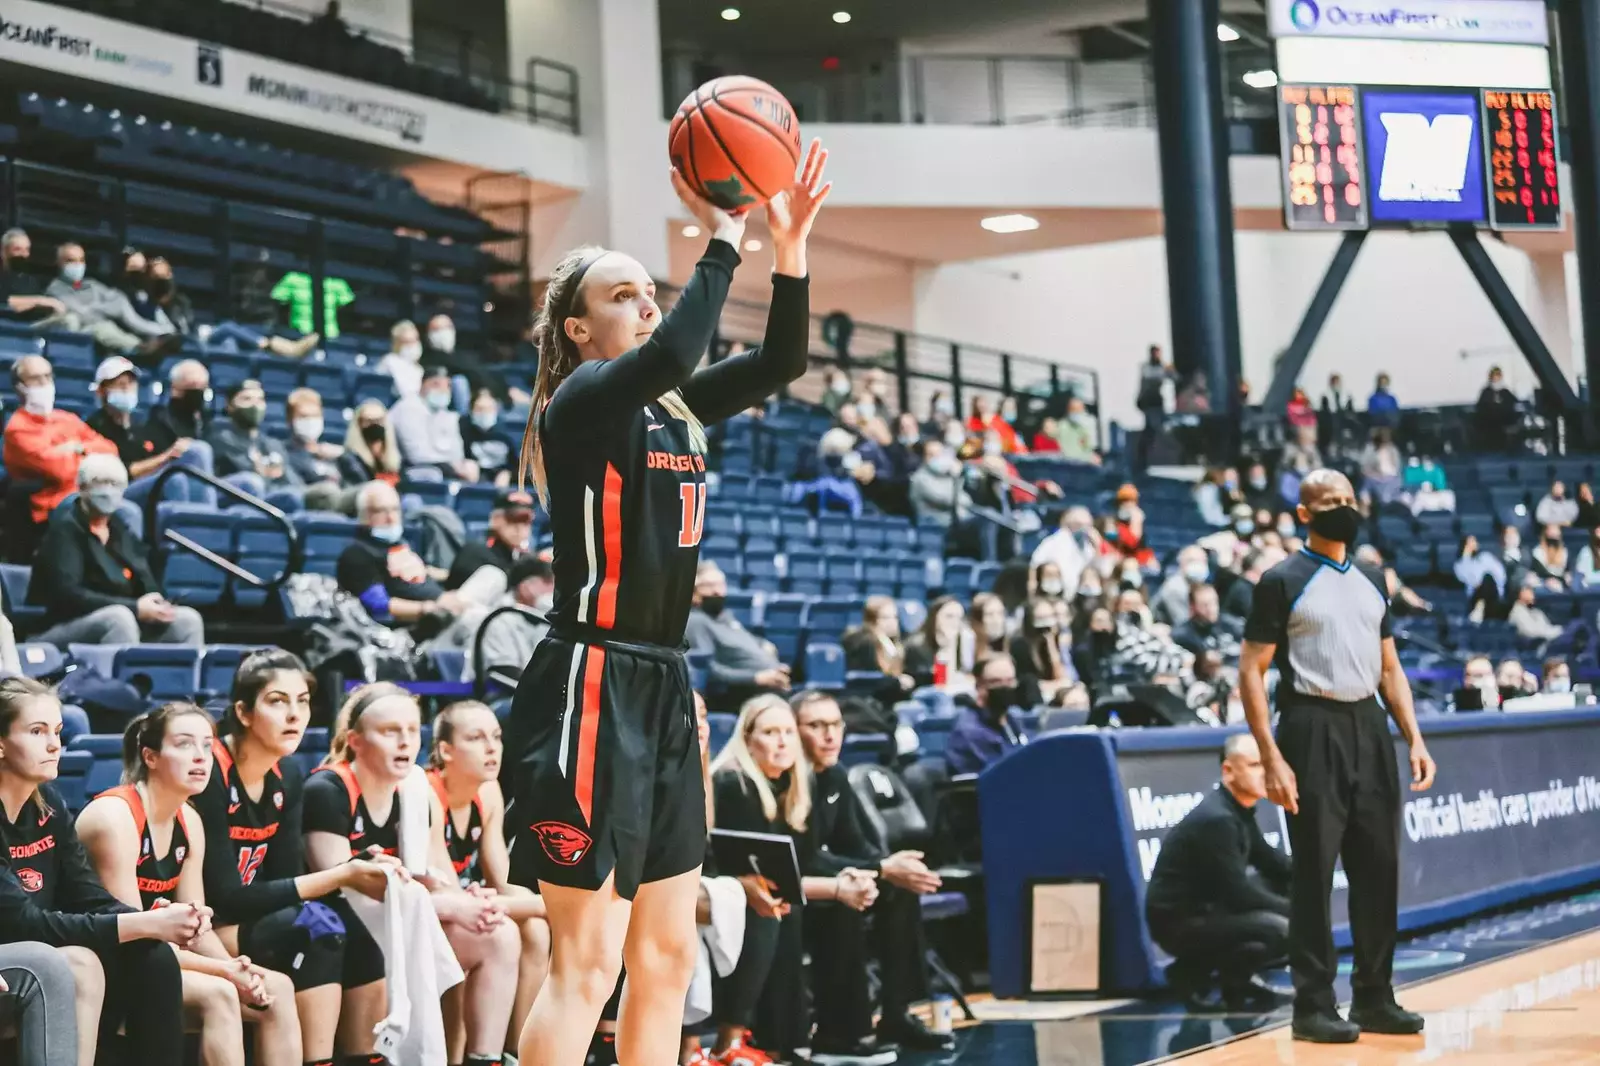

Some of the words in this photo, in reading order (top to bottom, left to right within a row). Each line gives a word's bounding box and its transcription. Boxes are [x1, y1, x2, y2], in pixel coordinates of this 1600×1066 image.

[1404, 794, 1460, 843] Official
[1457, 788, 1503, 833] health
[1501, 793, 1529, 827] care
[1527, 779, 1575, 828] provider
[237, 843, 268, 887] 12
